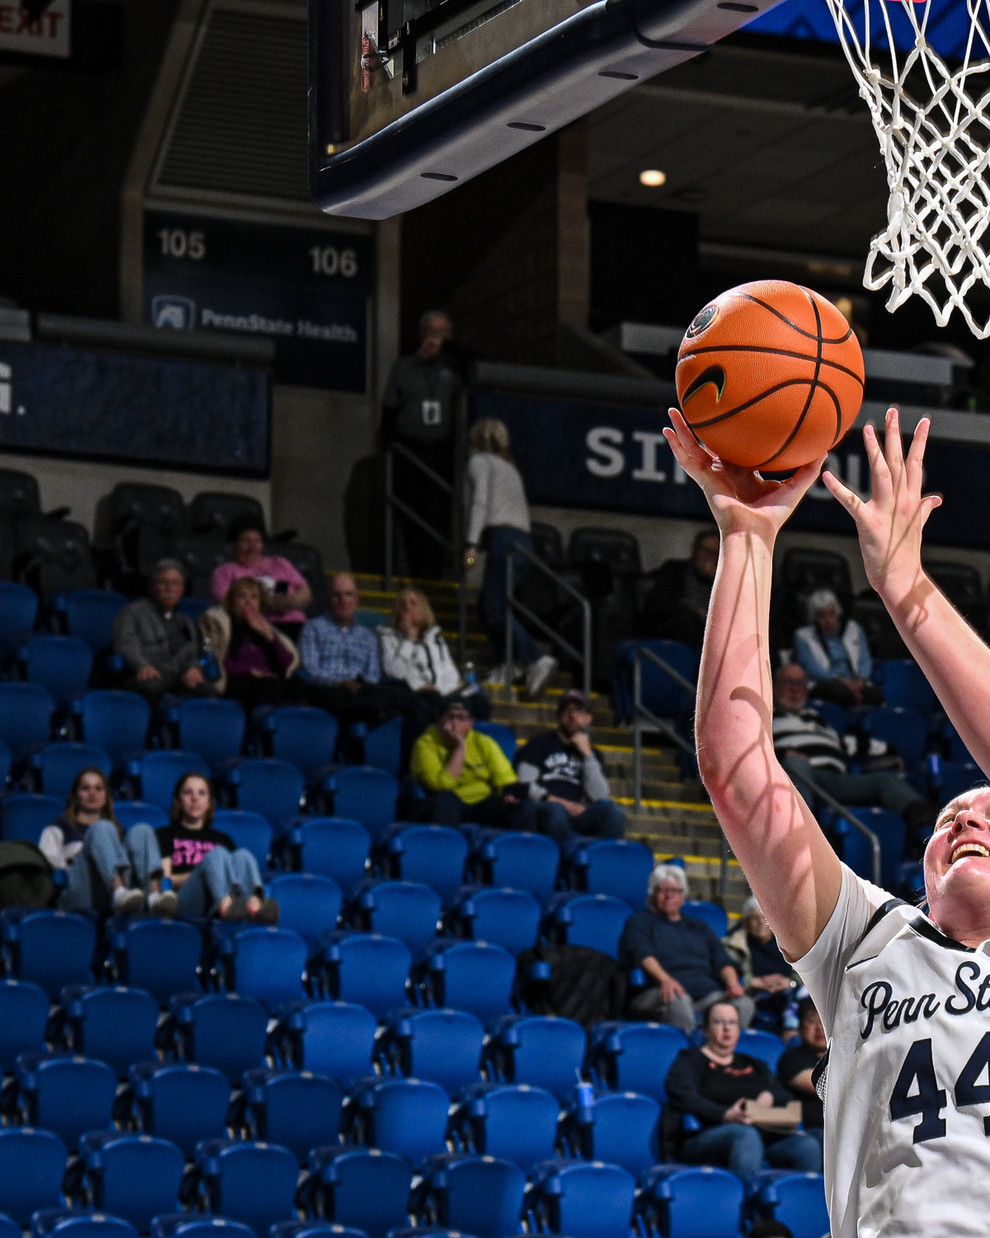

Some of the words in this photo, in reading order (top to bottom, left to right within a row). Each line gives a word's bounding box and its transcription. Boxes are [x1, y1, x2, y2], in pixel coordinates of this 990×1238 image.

[157, 228, 207, 260] 105
[309, 245, 359, 278] 106
[201, 308, 295, 337] PennState
[297, 319, 359, 344] Health
[860, 980, 941, 1040] Penn
